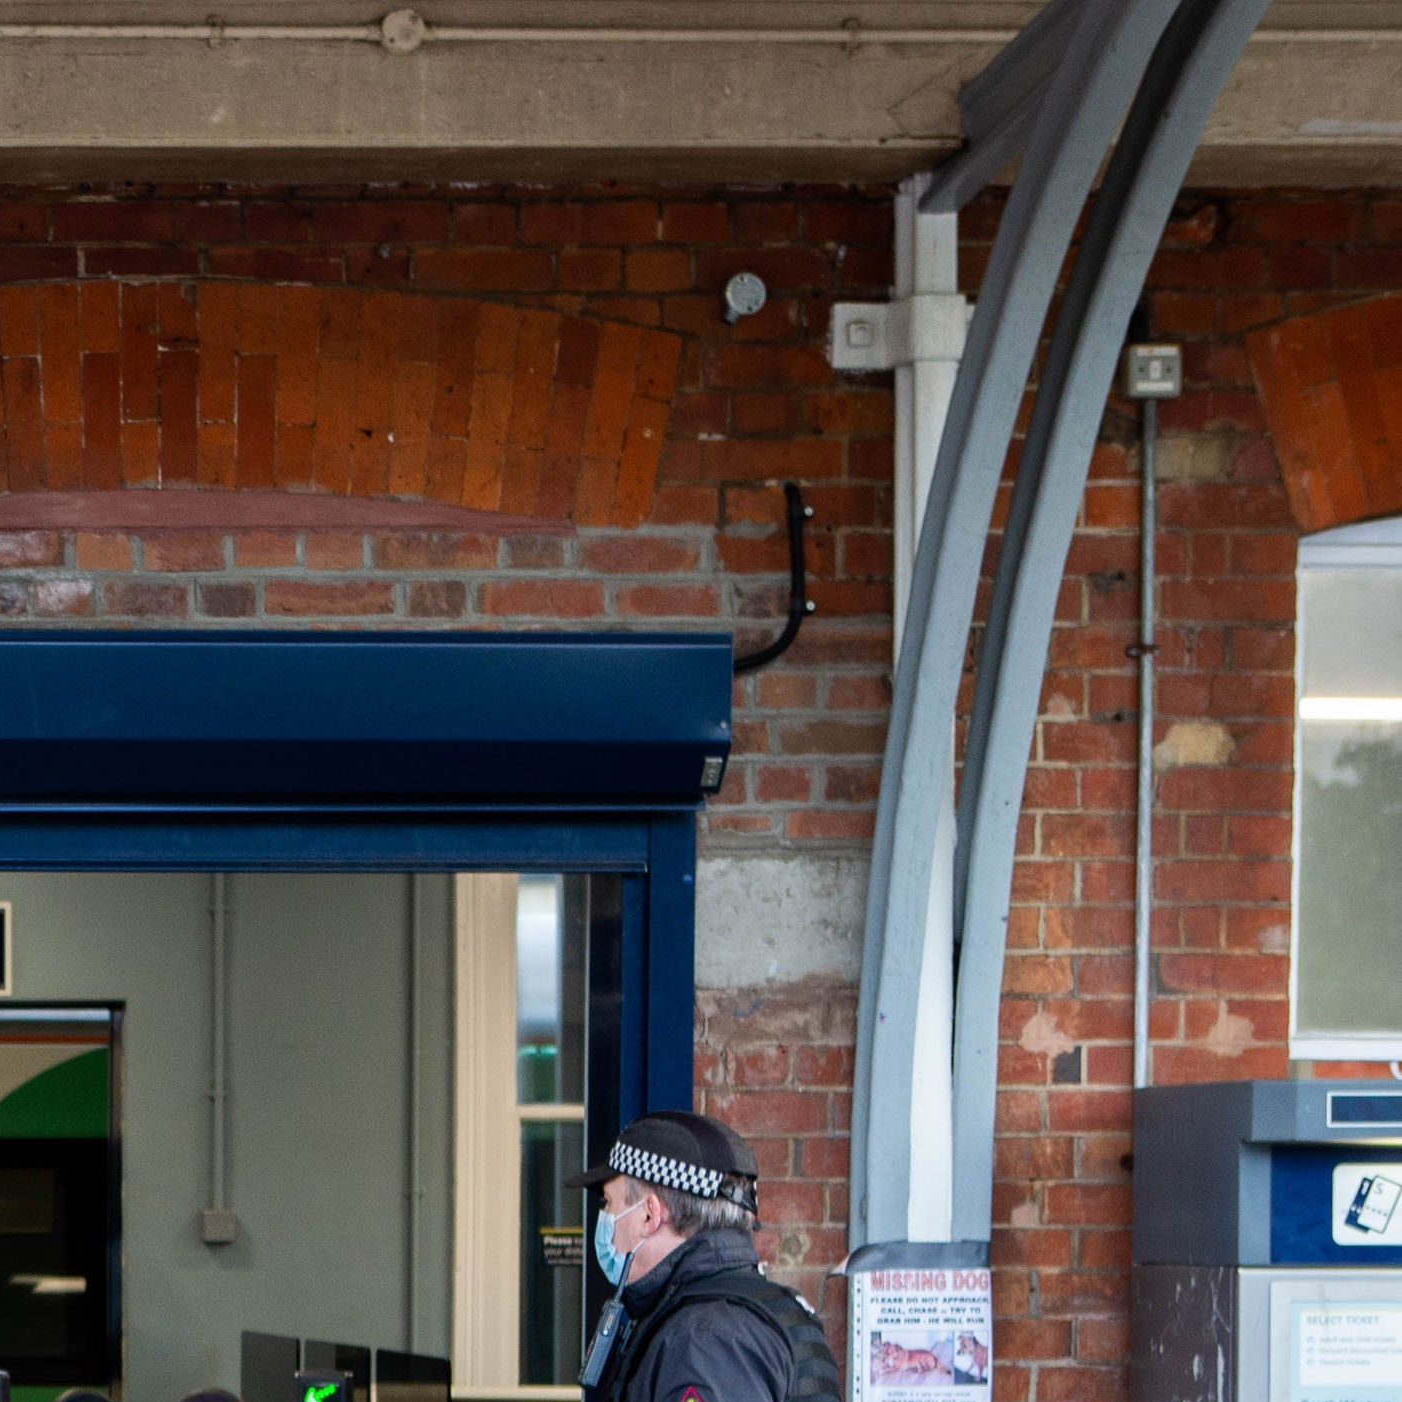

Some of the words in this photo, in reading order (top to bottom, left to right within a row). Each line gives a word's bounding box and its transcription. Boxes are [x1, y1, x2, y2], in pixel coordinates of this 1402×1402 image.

[870, 1271, 947, 1292] MISSING
[952, 1271, 989, 1292] DOG
[1306, 1315, 1343, 1326] SELECT
[1345, 1315, 1380, 1326] TICKET
